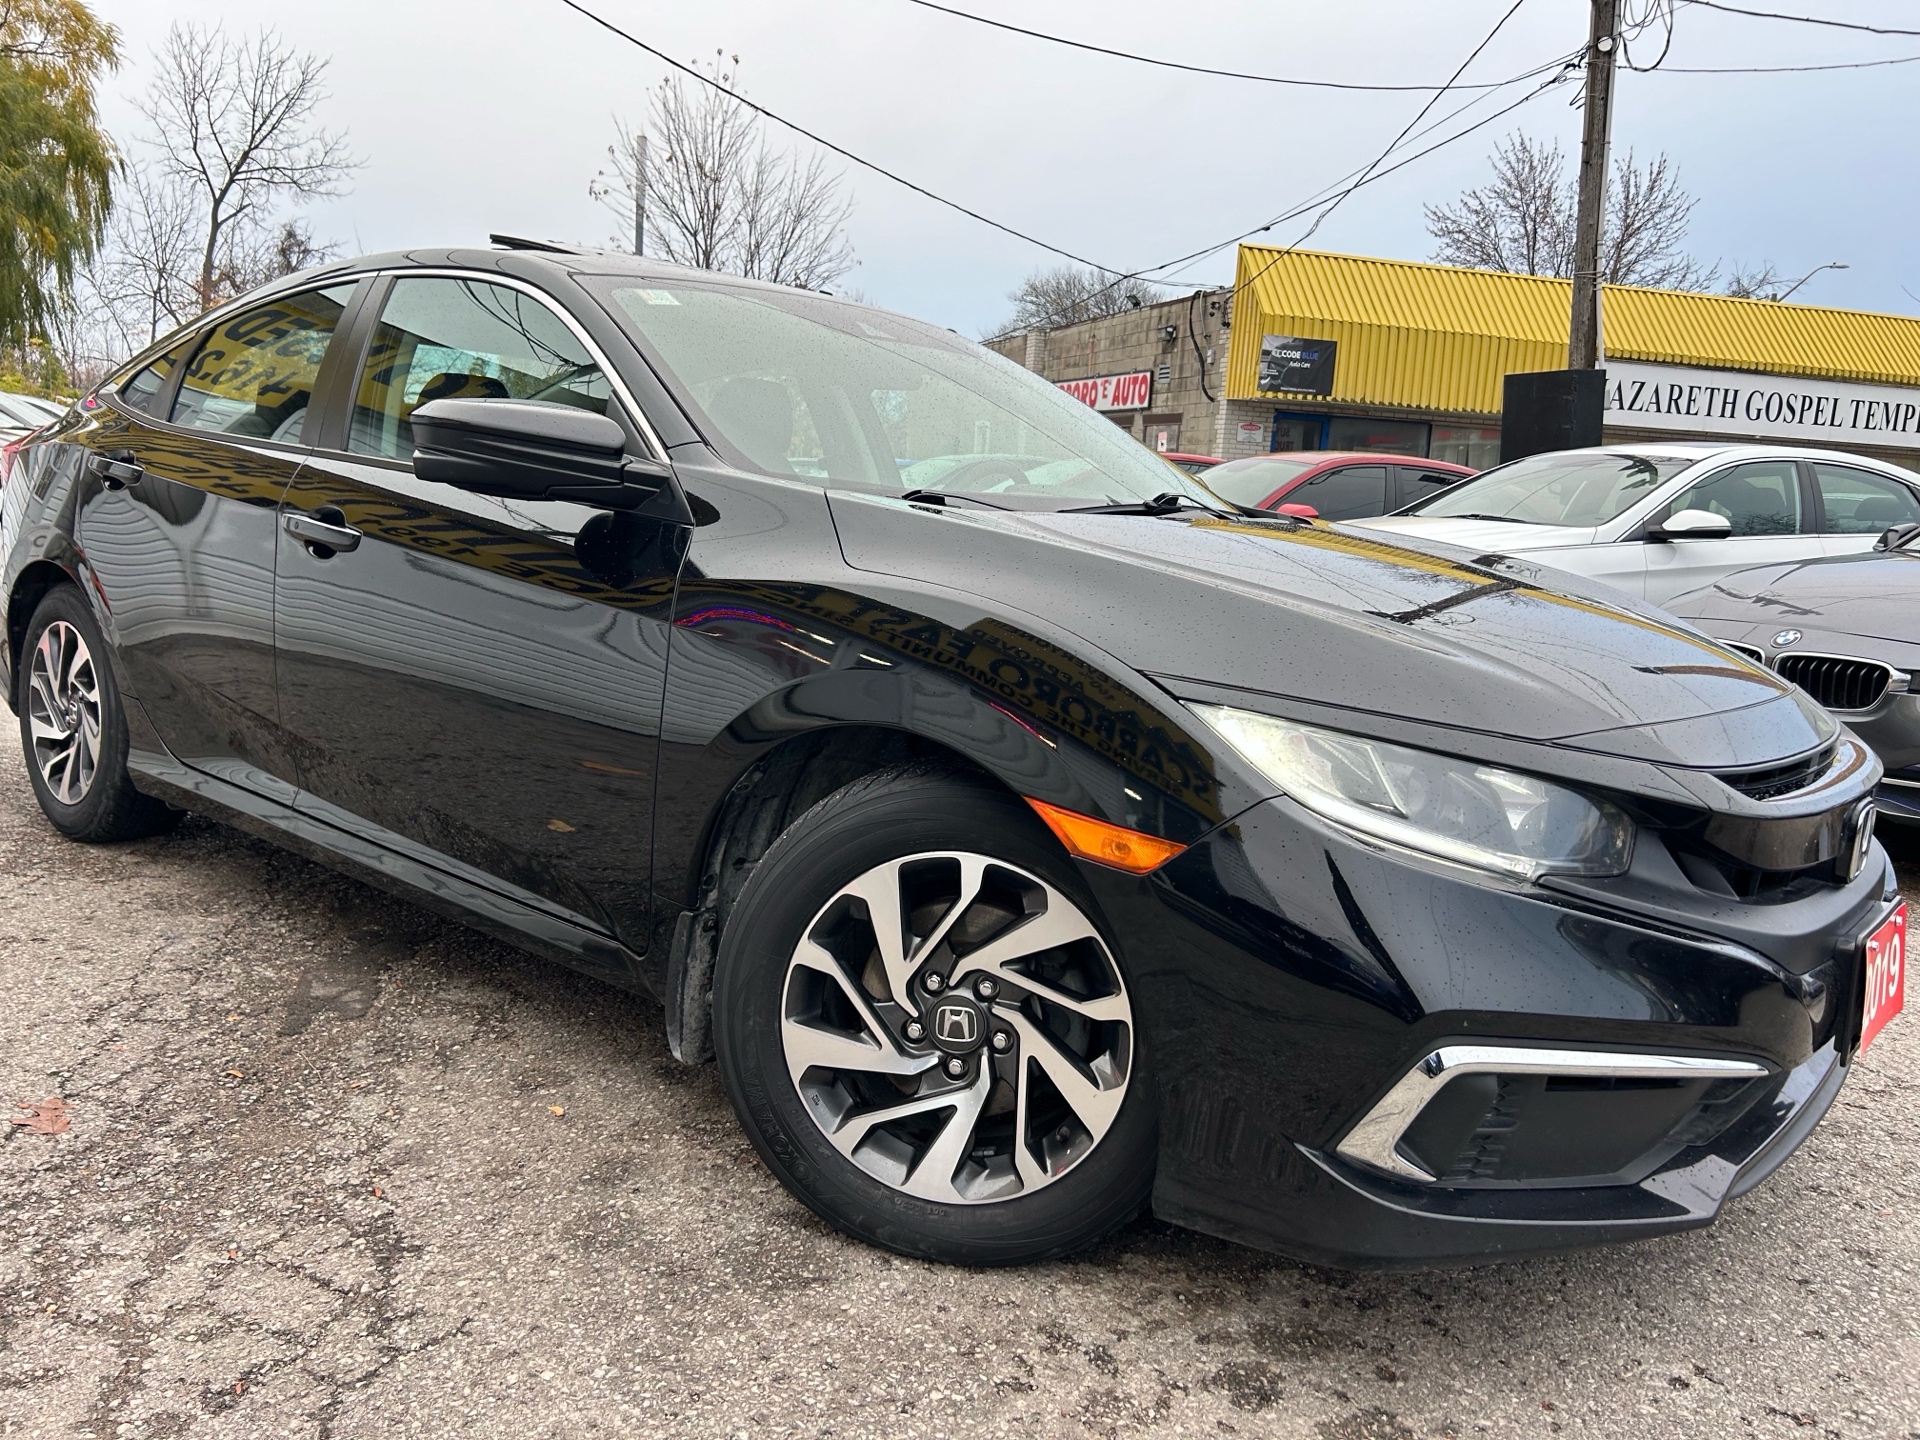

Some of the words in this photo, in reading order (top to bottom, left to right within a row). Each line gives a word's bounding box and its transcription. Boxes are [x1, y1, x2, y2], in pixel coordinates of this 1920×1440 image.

[1302, 352, 1319, 360] BLUE
[1058, 380, 1098, 408] ORO
[1111, 374, 1149, 406] AUTO
[1604, 379, 1740, 419] AZARETH
[1745, 390, 1844, 428] GOSPEL
